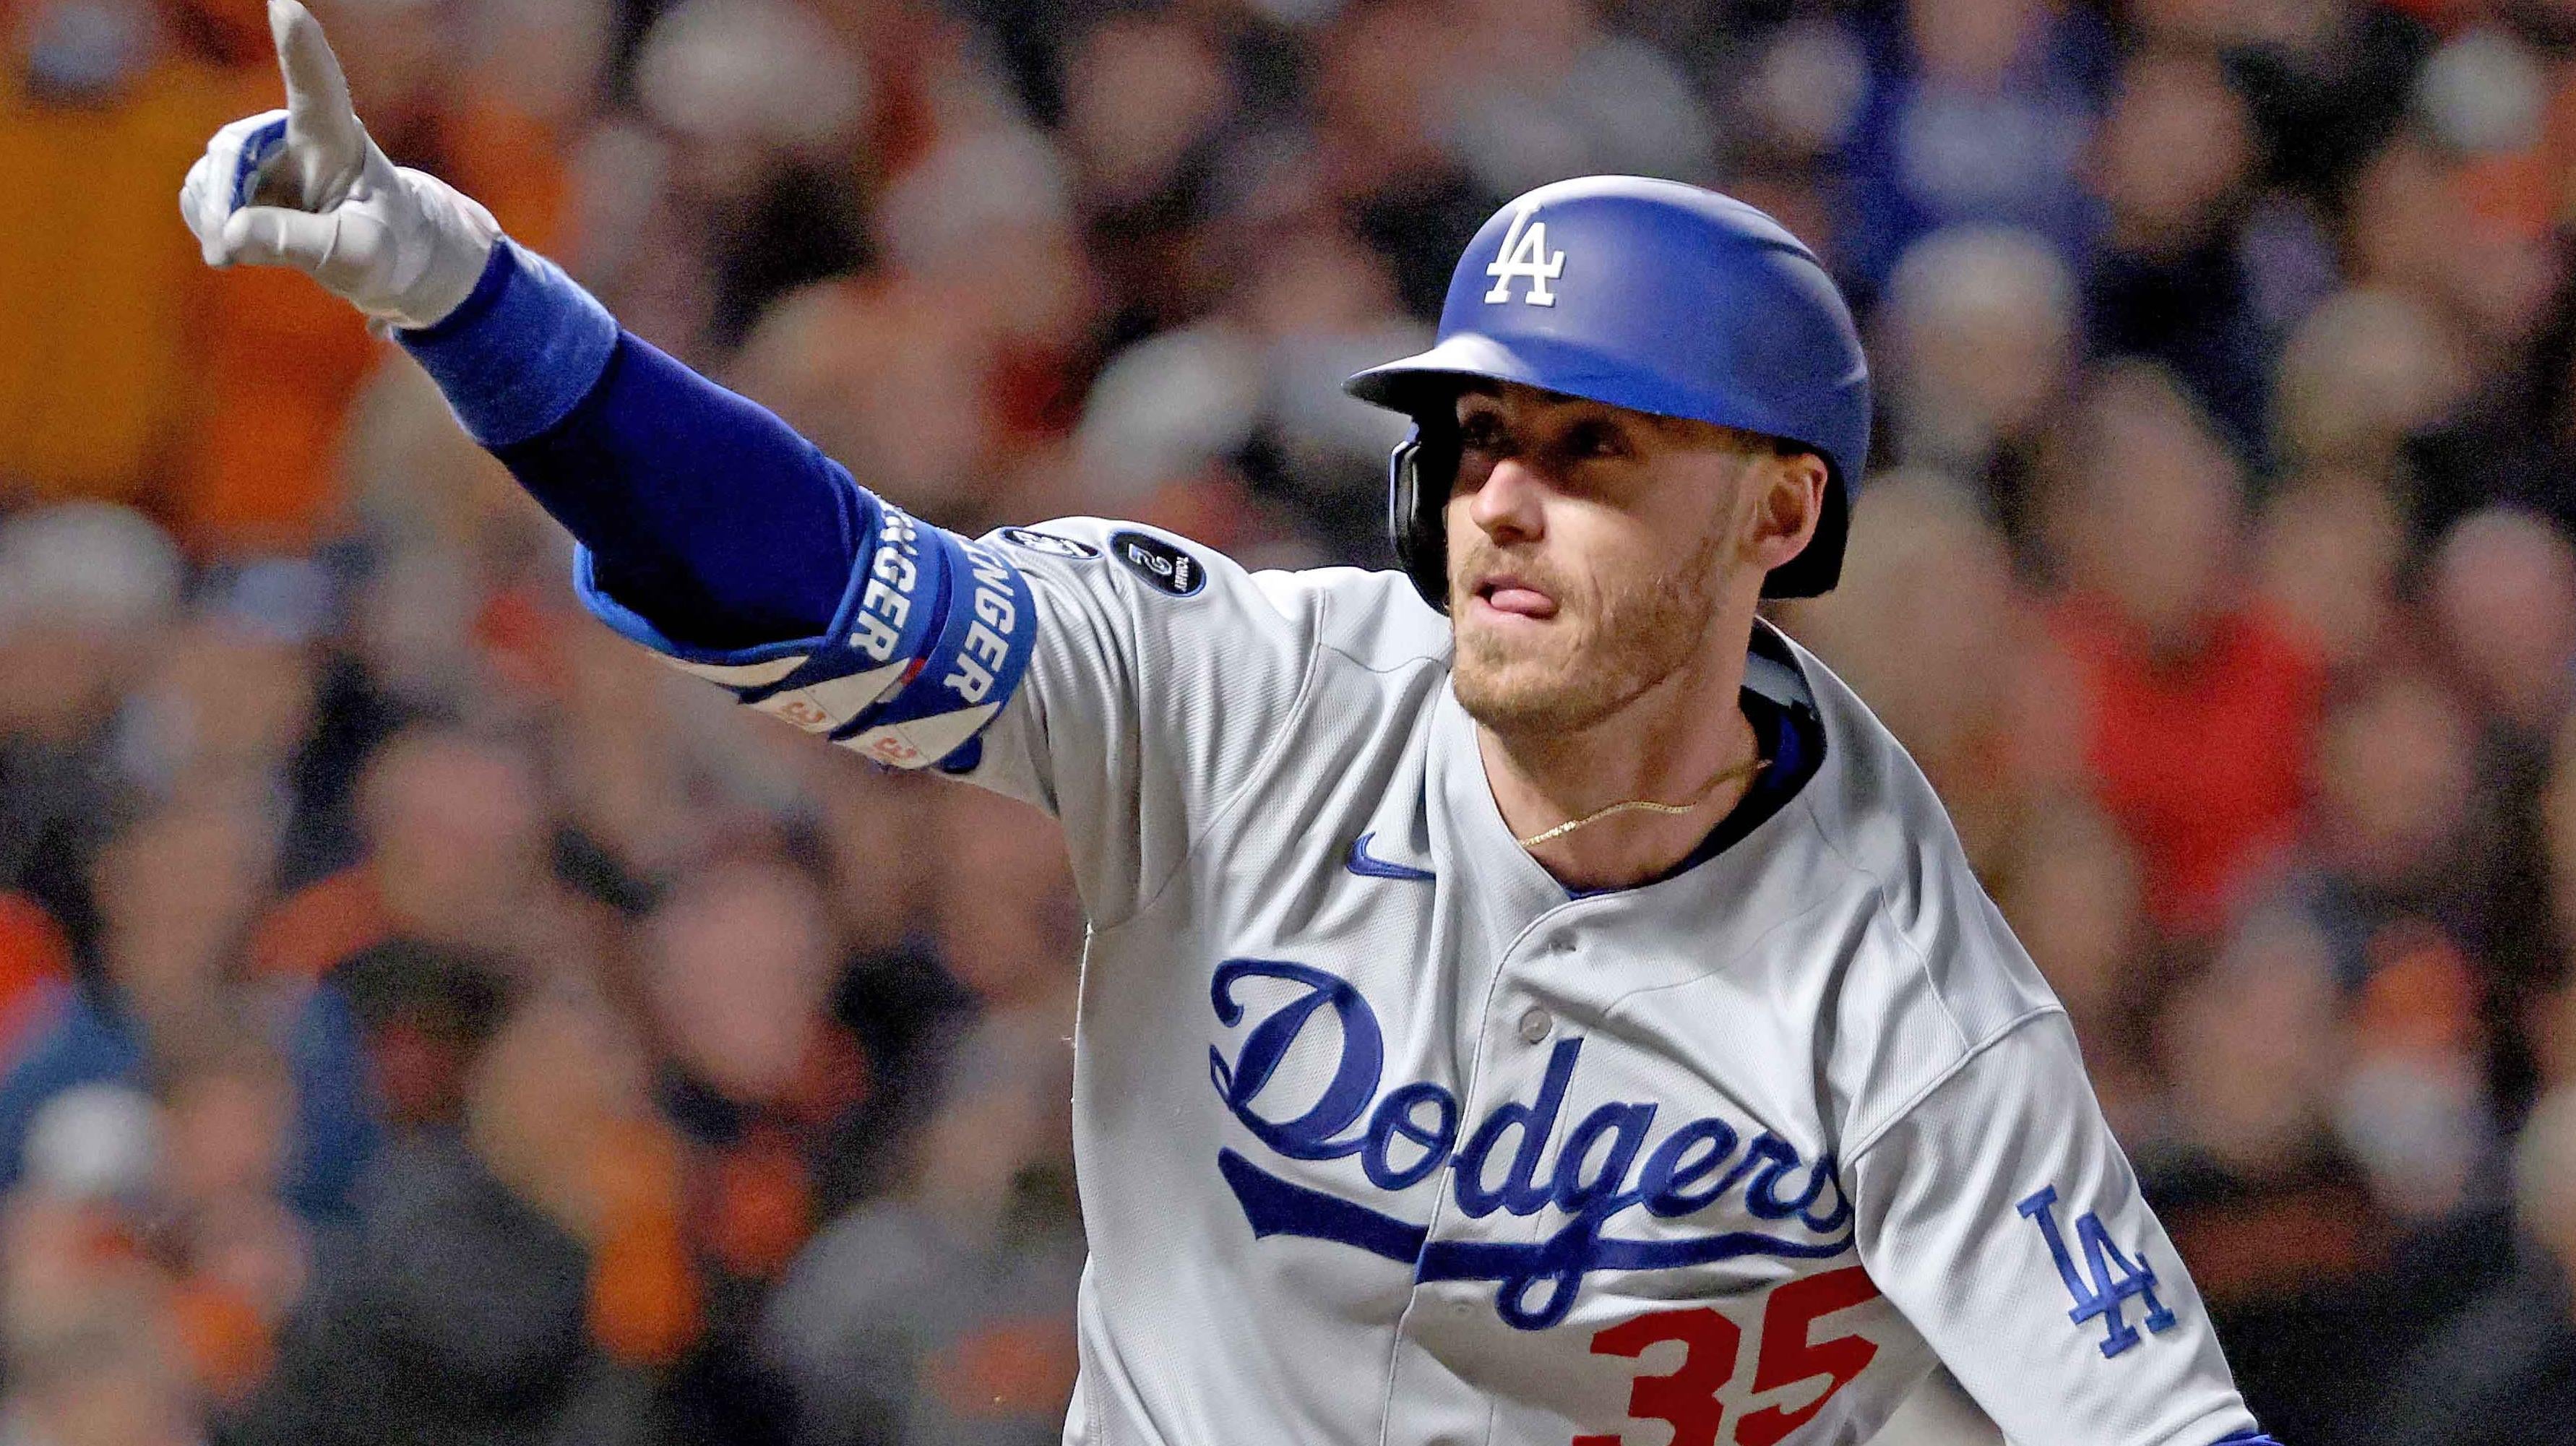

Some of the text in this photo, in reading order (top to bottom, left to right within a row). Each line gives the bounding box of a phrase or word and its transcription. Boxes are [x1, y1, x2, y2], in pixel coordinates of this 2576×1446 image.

[1484, 201, 1566, 307] LA
[1128, 543, 1172, 576] 2
[1210, 959, 1856, 1331] Dodgers
[1571, 1265, 1882, 1446] 35
[2016, 1184, 2176, 1359] LA
